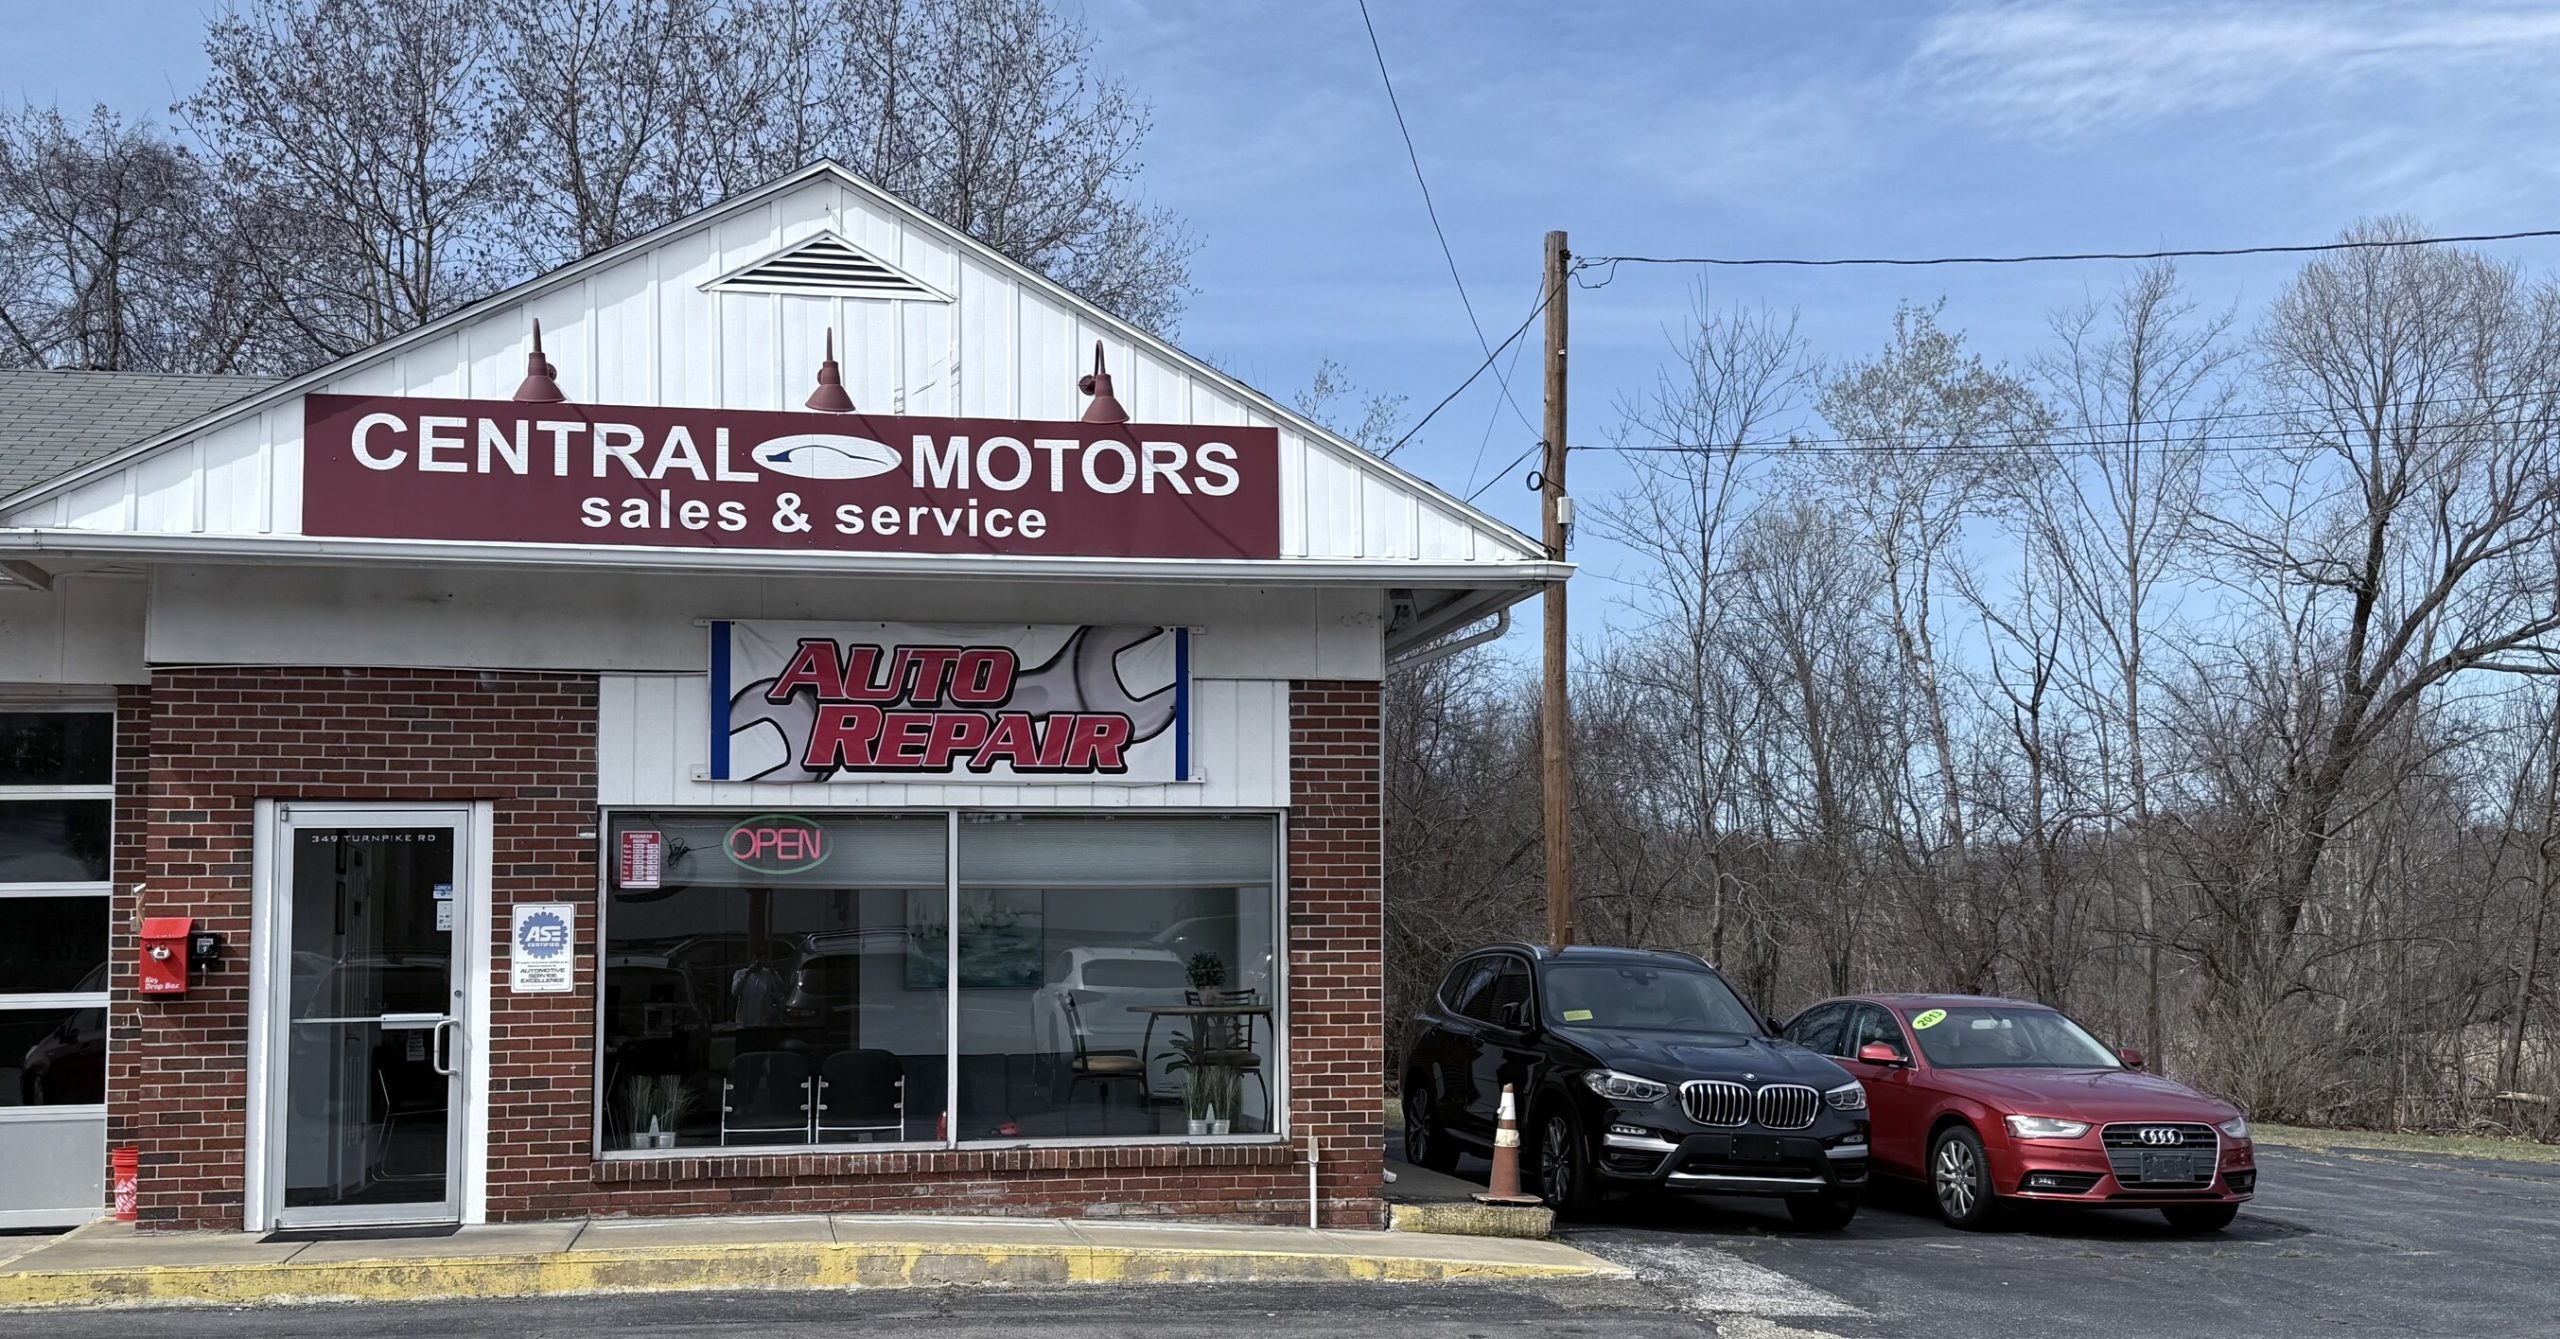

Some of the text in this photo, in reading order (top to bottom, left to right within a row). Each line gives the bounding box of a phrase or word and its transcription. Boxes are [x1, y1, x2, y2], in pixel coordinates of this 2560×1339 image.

[351, 412, 1241, 497] CENTRAL MOTORS
[581, 487, 1047, 538] sales & service
[768, 638, 1018, 704] AUTO
[803, 704, 1131, 771] REPAIR
[311, 834, 436, 843] 349 TURNPIKE RD
[730, 828, 821, 860] OPEN
[525, 925, 561, 942] ASE
[1917, 1010, 1942, 1027] 2013
